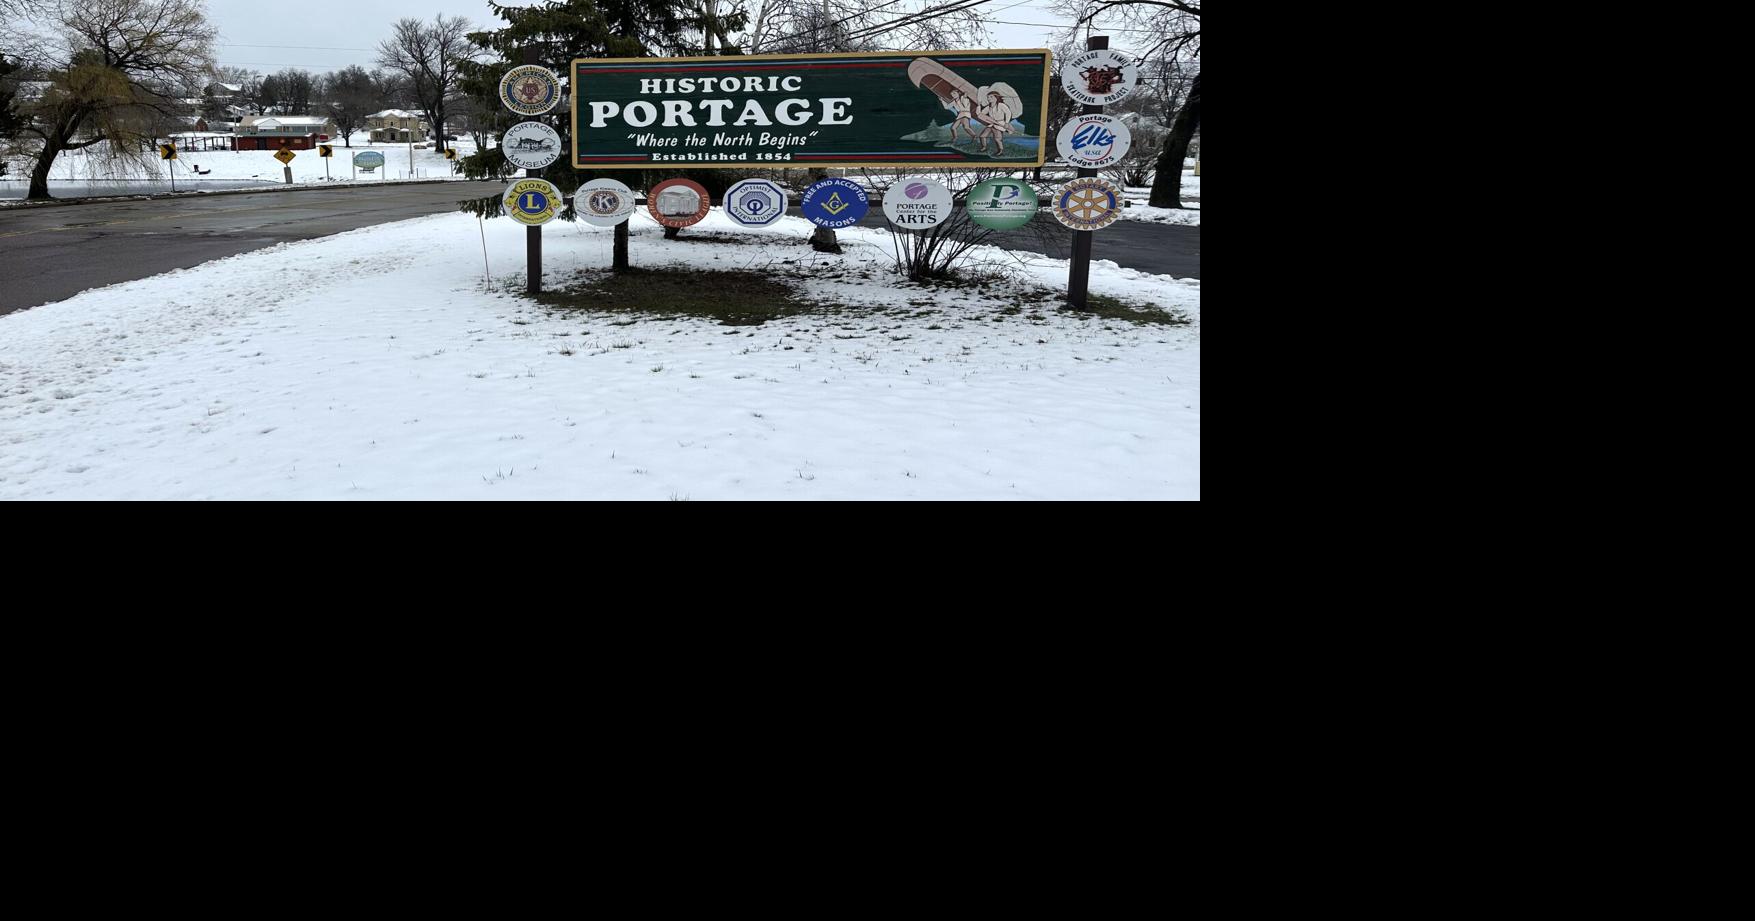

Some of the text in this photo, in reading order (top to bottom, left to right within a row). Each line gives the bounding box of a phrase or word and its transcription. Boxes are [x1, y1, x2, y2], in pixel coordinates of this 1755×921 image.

[1071, 52, 1098, 68] PORTAGE
[640, 76, 802, 94] HISTORIC
[1104, 87, 1129, 103] PROJECT
[588, 97, 853, 128] PORTAGE
[1079, 115, 1112, 123] Portage
[508, 123, 555, 137] PORTAGE
[1071, 125, 1117, 150] Elks
[685, 133, 707, 147] the
[713, 132, 753, 146] North
[508, 153, 557, 168] MUSEUM
[652, 152, 791, 161] Established 1854
[1068, 154, 1093, 166] Lodge
[519, 183, 548, 191] LIONS
[803, 180, 866, 203] FREE AND ACCEPTED
[525, 194, 541, 209] L
[829, 200, 840, 209] G
[813, 216, 856, 227] MASONS
[895, 214, 937, 224] ARTS
